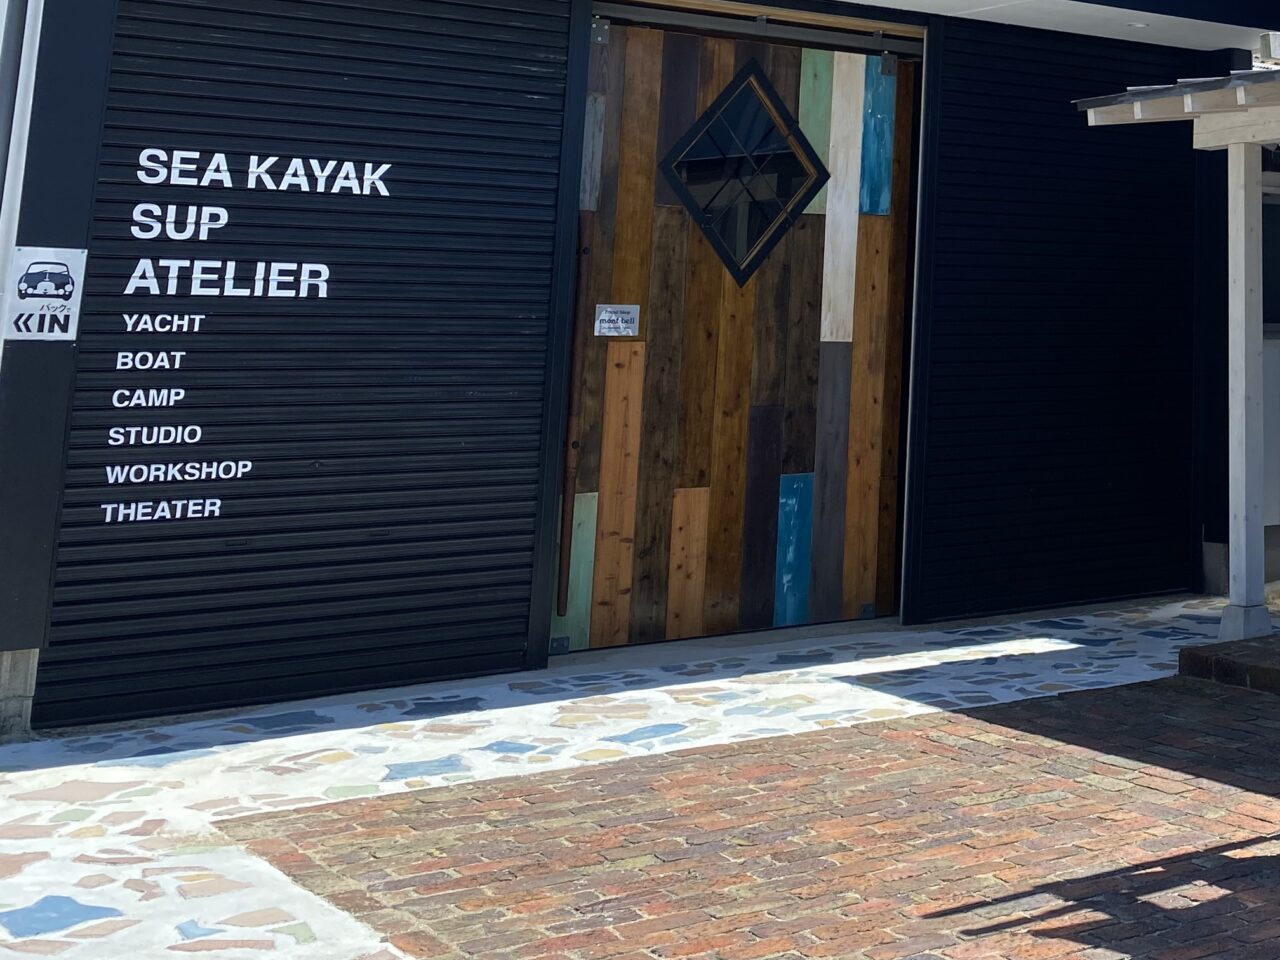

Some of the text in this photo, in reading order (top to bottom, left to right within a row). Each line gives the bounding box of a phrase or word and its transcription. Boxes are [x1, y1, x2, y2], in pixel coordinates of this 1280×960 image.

[137, 149, 391, 196] SEA KAYAK
[131, 203, 228, 240] SUP
[124, 259, 329, 297] ATELIER
[37, 313, 70, 333] IN
[123, 314, 205, 332] YACHT
[116, 352, 186, 369] BOAT
[113, 389, 185, 407] CAMP
[108, 426, 201, 445] STUDIO
[106, 461, 252, 483] WORKSHOP
[101, 499, 221, 522] THEATER
